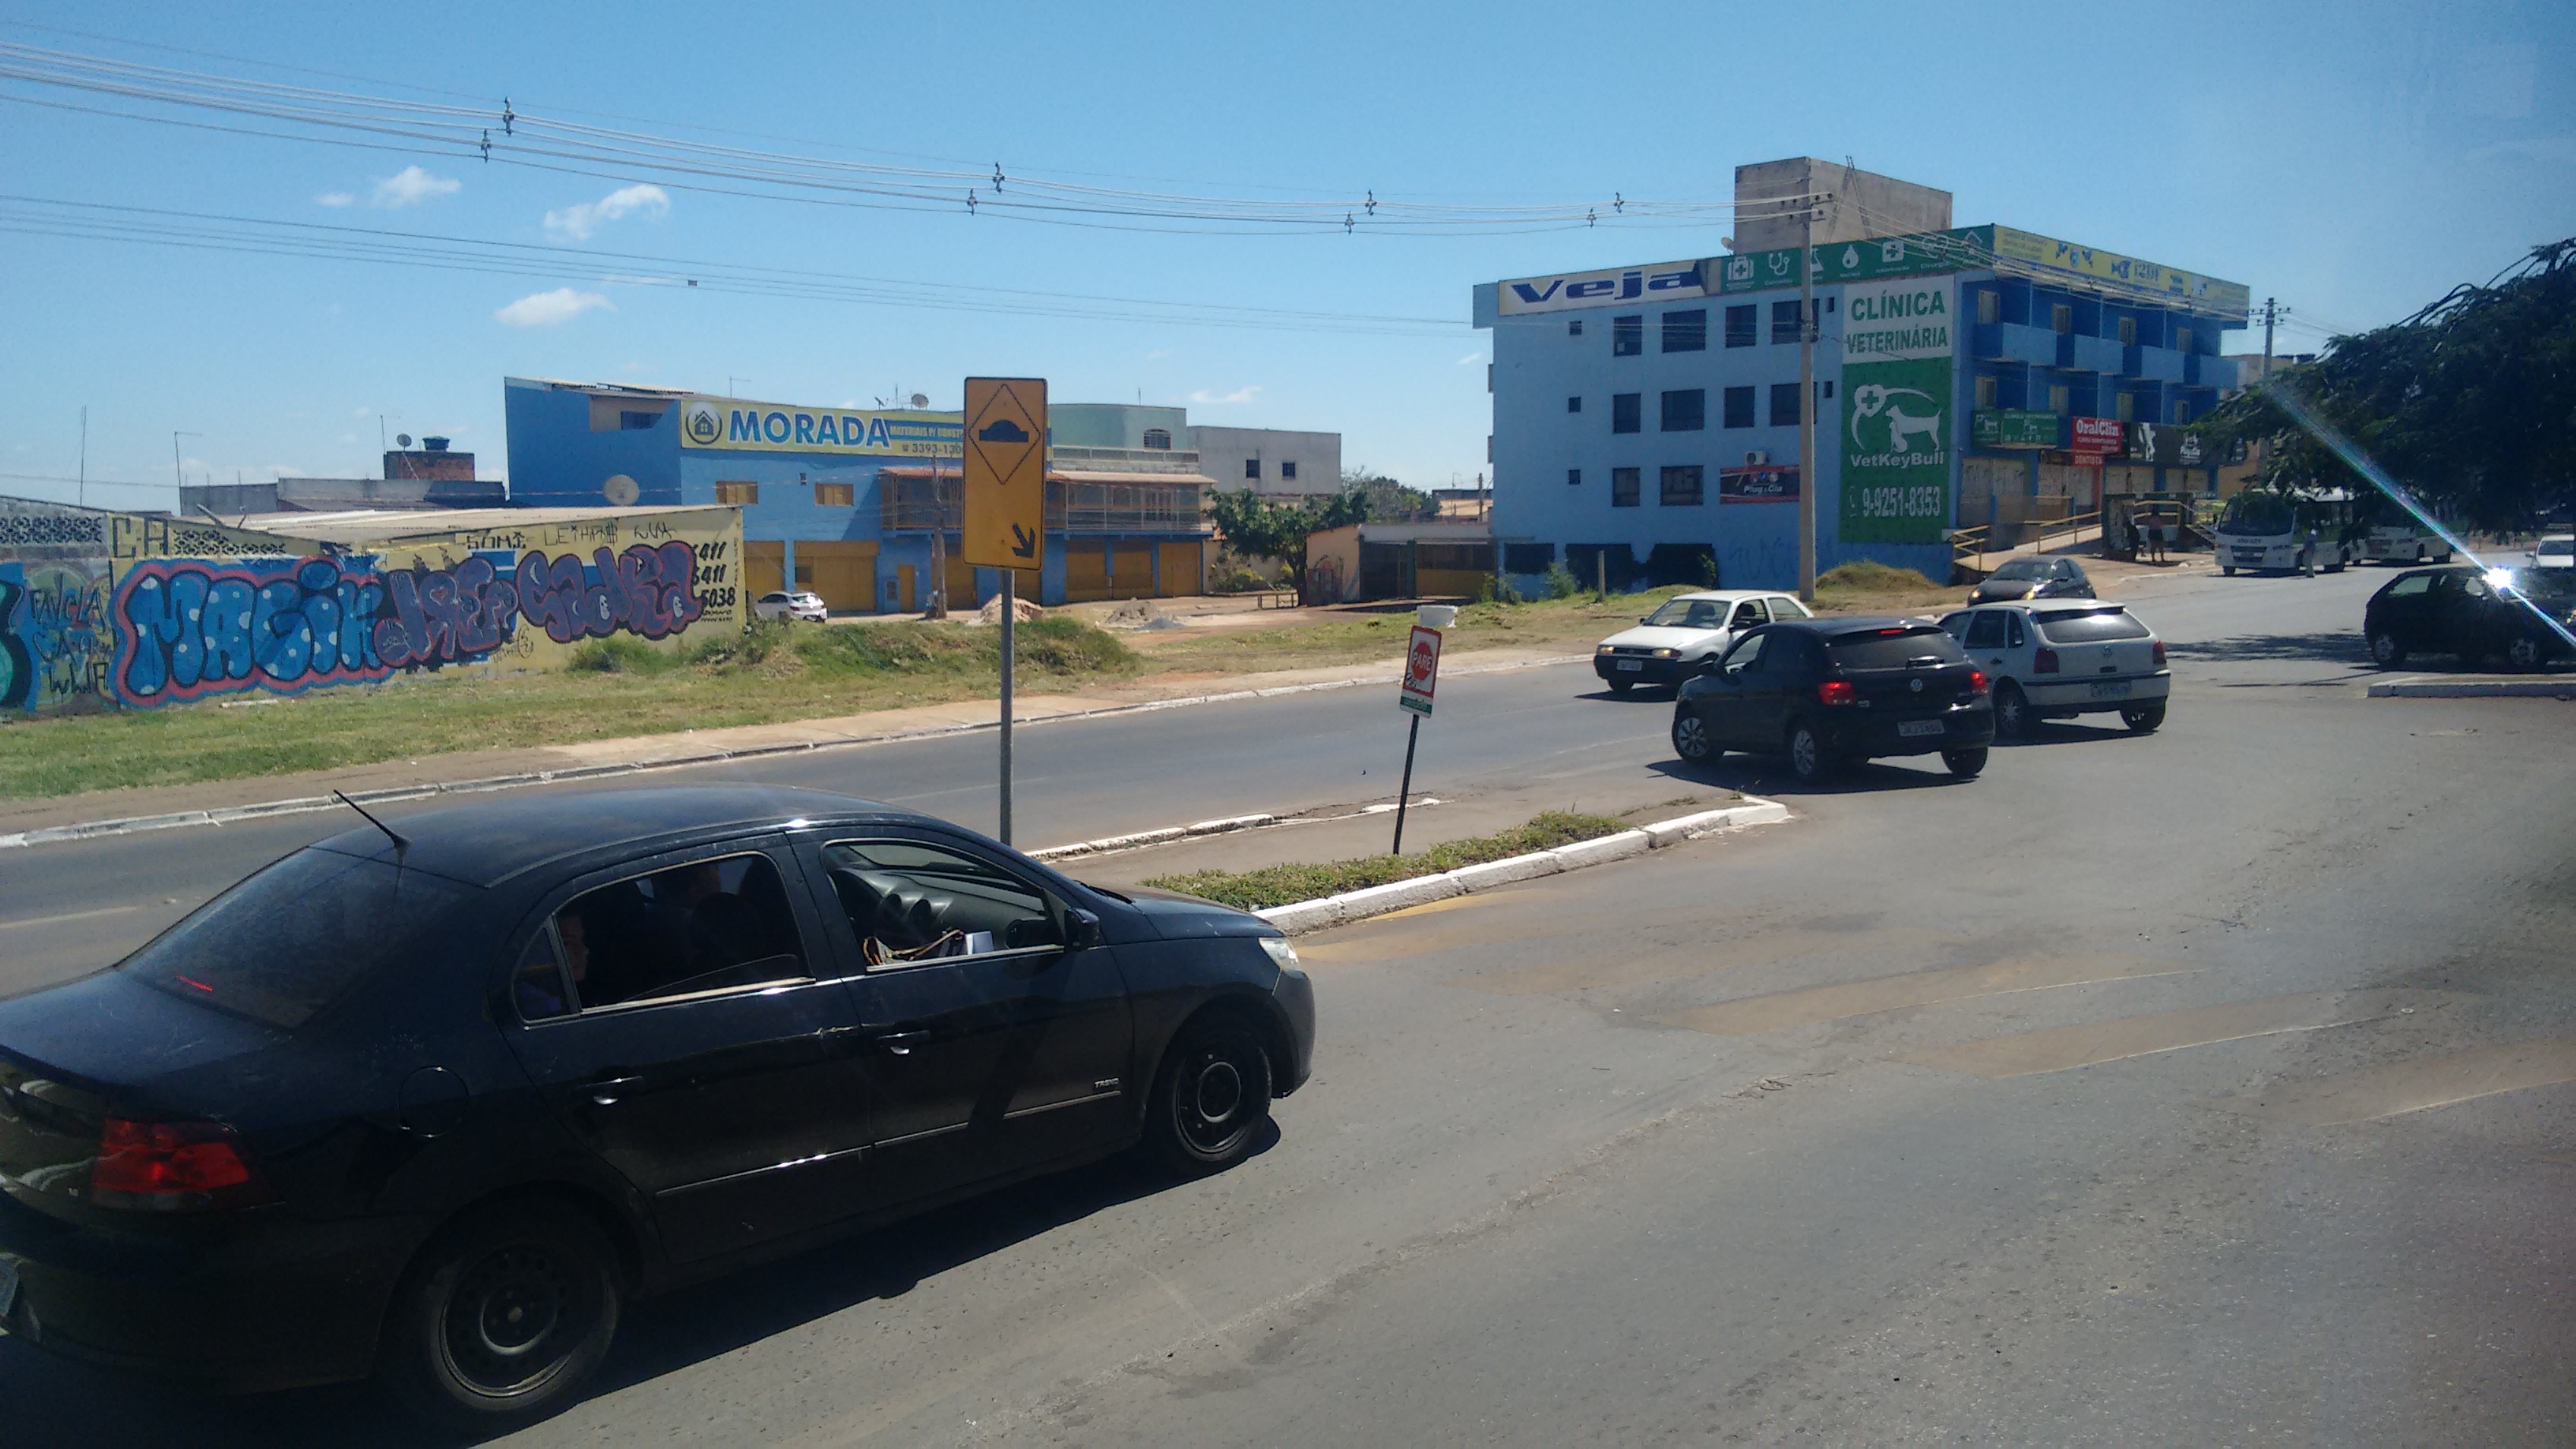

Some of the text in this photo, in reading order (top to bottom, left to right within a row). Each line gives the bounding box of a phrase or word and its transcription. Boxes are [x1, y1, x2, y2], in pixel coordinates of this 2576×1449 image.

[1511, 271, 1702, 303] Veja
[1851, 290, 1945, 321] CLÍNICA
[1847, 325, 1948, 354] VETERINÁRIA
[728, 409, 891, 449] MORADA
[2076, 418, 2119, 436] OralClin
[1850, 451, 1944, 468] VetKeyBull
[1863, 486, 1941, 517] 9-9251-8353
[1413, 652, 1432, 672] PARE
